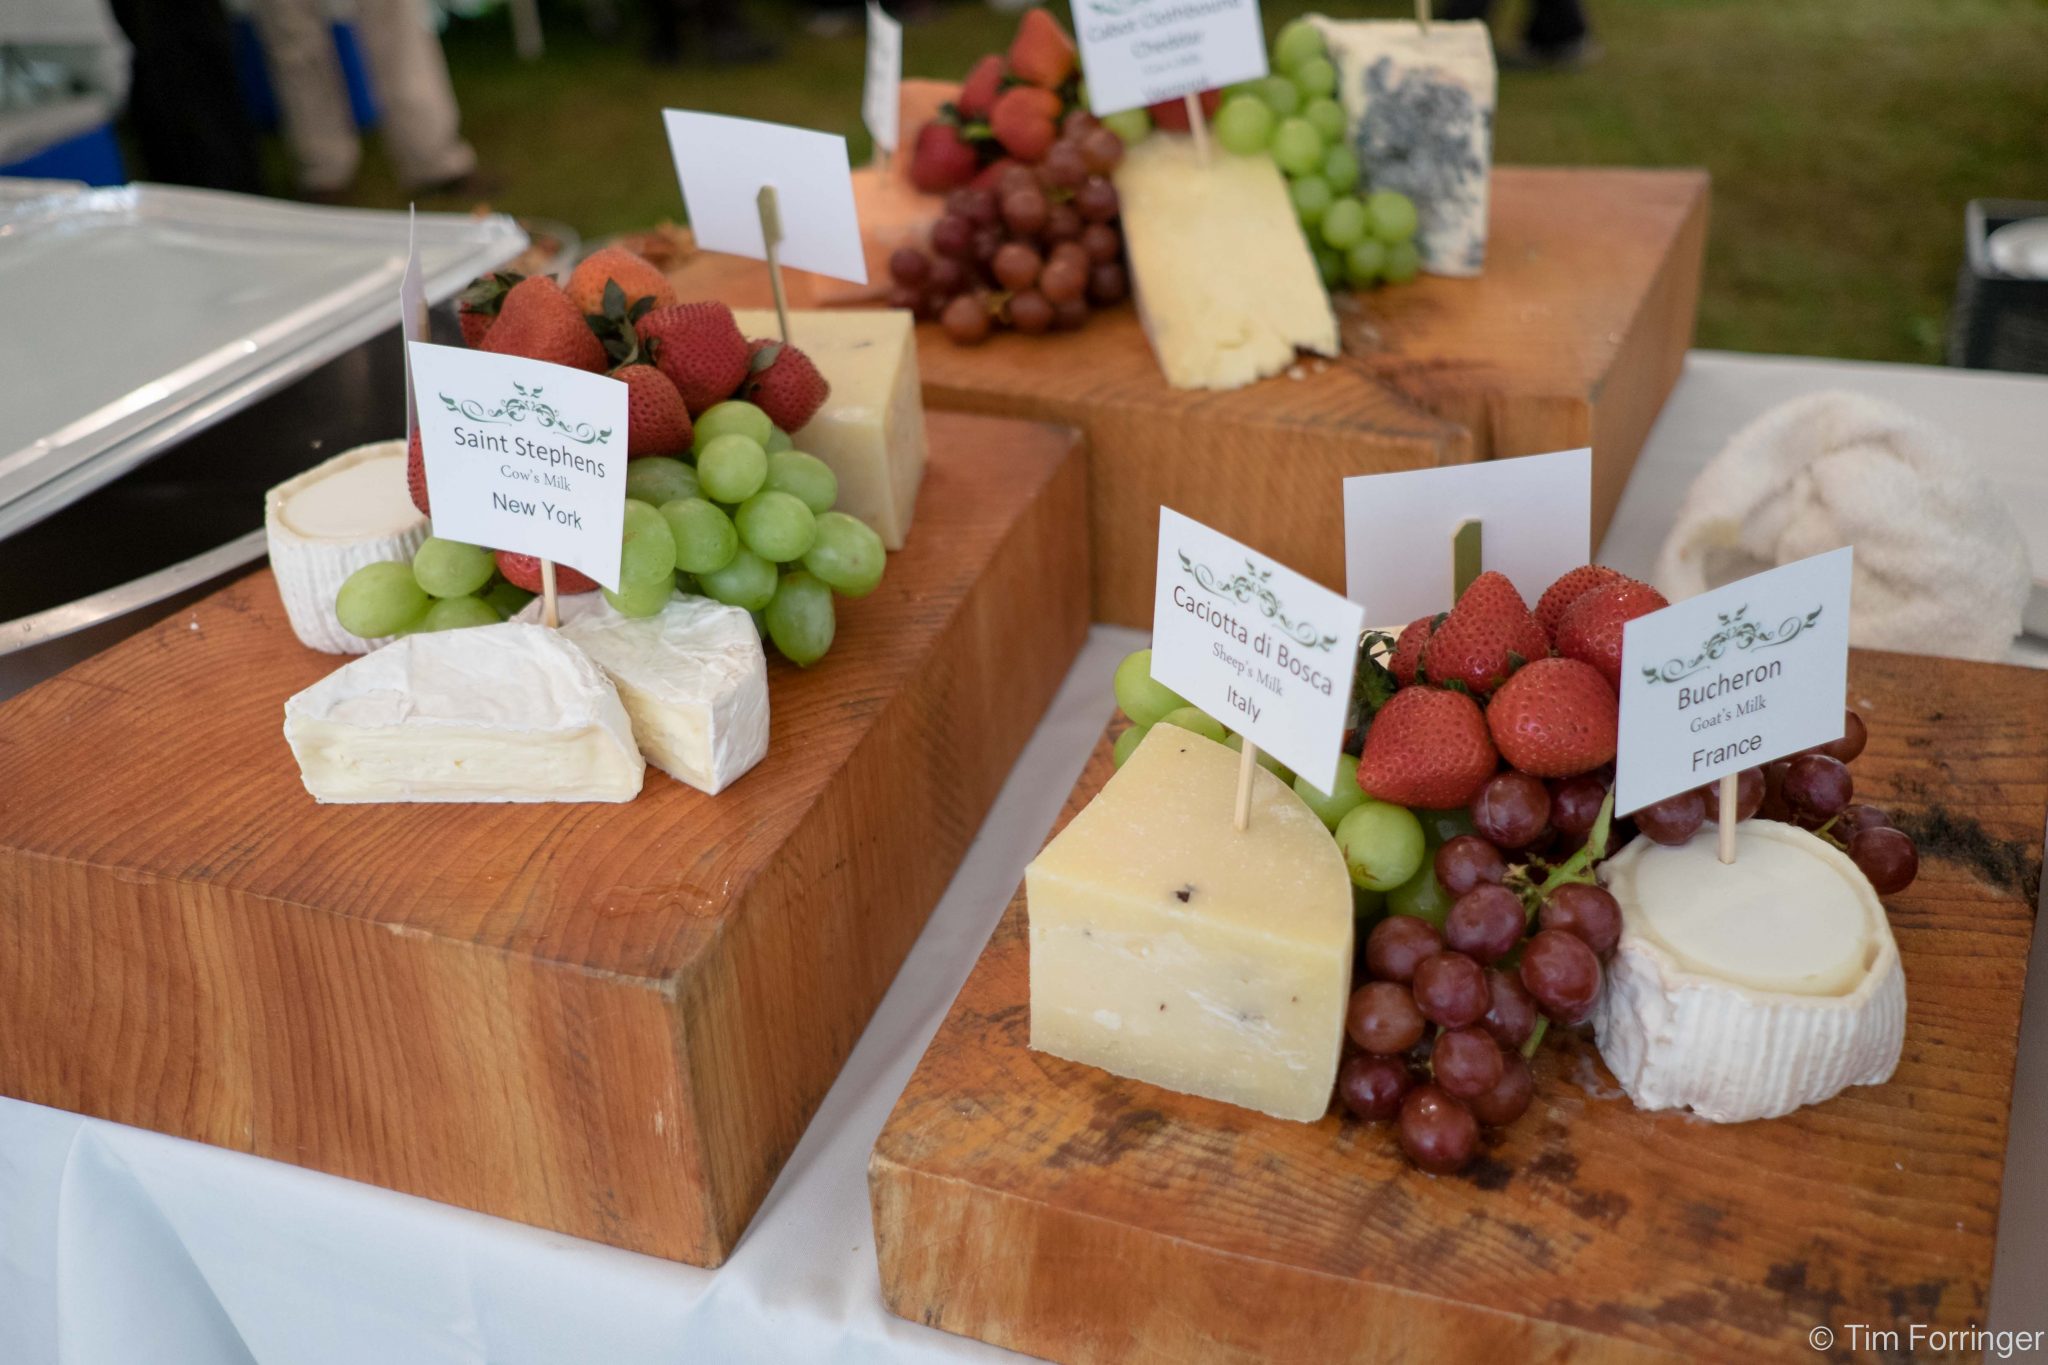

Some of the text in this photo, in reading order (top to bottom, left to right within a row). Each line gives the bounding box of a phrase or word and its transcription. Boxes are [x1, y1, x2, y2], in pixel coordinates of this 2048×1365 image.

[454, 426, 606, 478] Saint Stephens
[500, 465, 572, 492] Cow's Milk
[492, 491, 583, 531] New York
[1173, 585, 1333, 696] Caciotta di Bosca
[1212, 642, 1283, 697] Sheep's Milk
[1678, 660, 1782, 710] Bucheron
[1227, 685, 1261, 723] Italy
[1690, 695, 1767, 733] Goat's Milk
[1692, 734, 1762, 772] France
